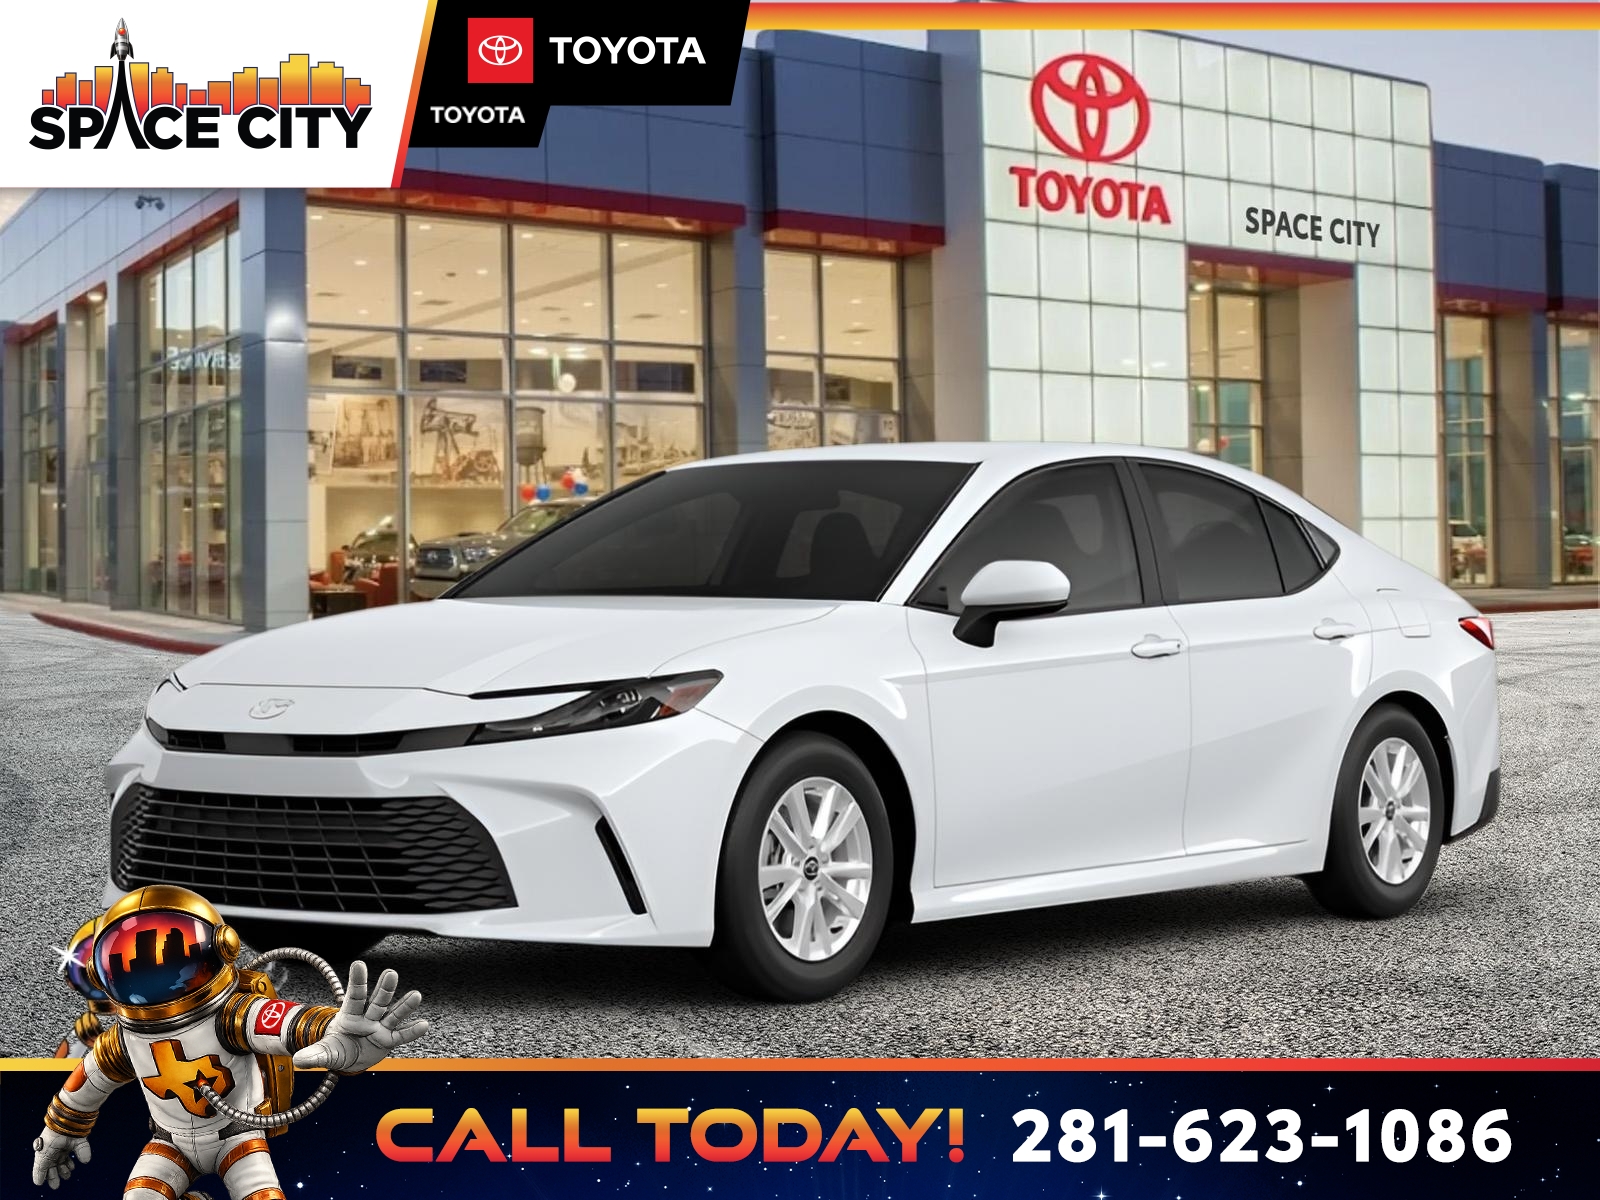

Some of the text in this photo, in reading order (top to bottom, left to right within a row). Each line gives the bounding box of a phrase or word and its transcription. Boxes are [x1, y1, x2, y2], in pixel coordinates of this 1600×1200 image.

[1009, 166, 1171, 225] TOYOTA
[1245, 206, 1381, 248] SPACE CITY
